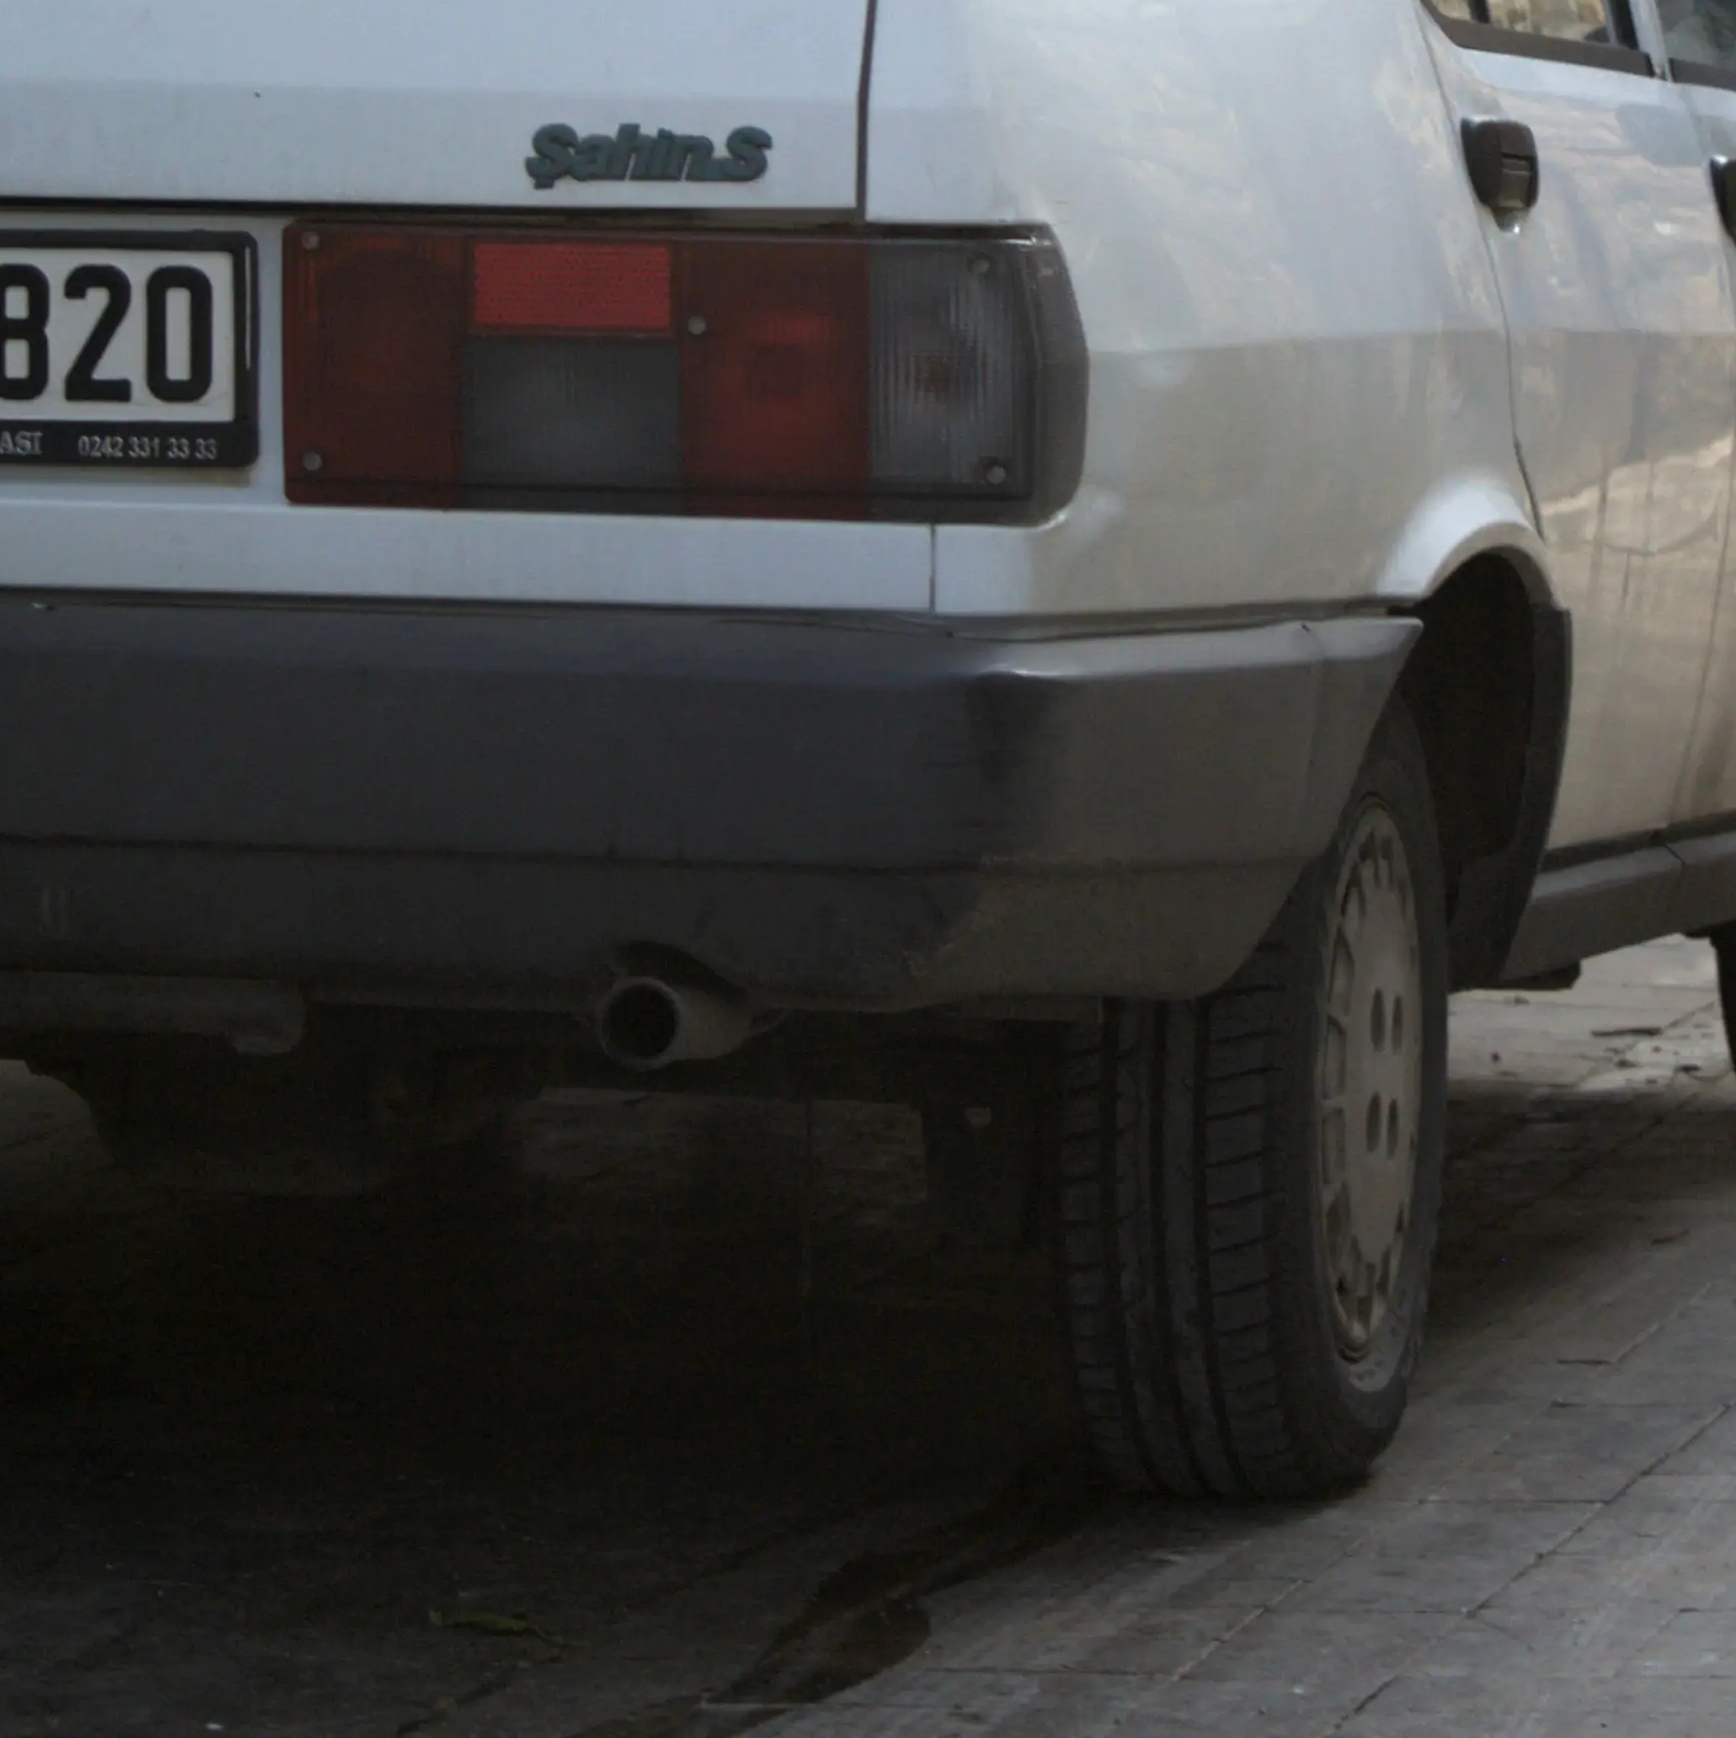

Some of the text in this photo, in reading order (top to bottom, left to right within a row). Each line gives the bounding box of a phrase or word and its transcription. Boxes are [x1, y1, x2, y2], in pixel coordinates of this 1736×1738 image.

[78, 435, 123, 458] 0242
[128, 436, 160, 459] 331
[168, 437, 190, 459] 33
[195, 438, 217, 459] 33
